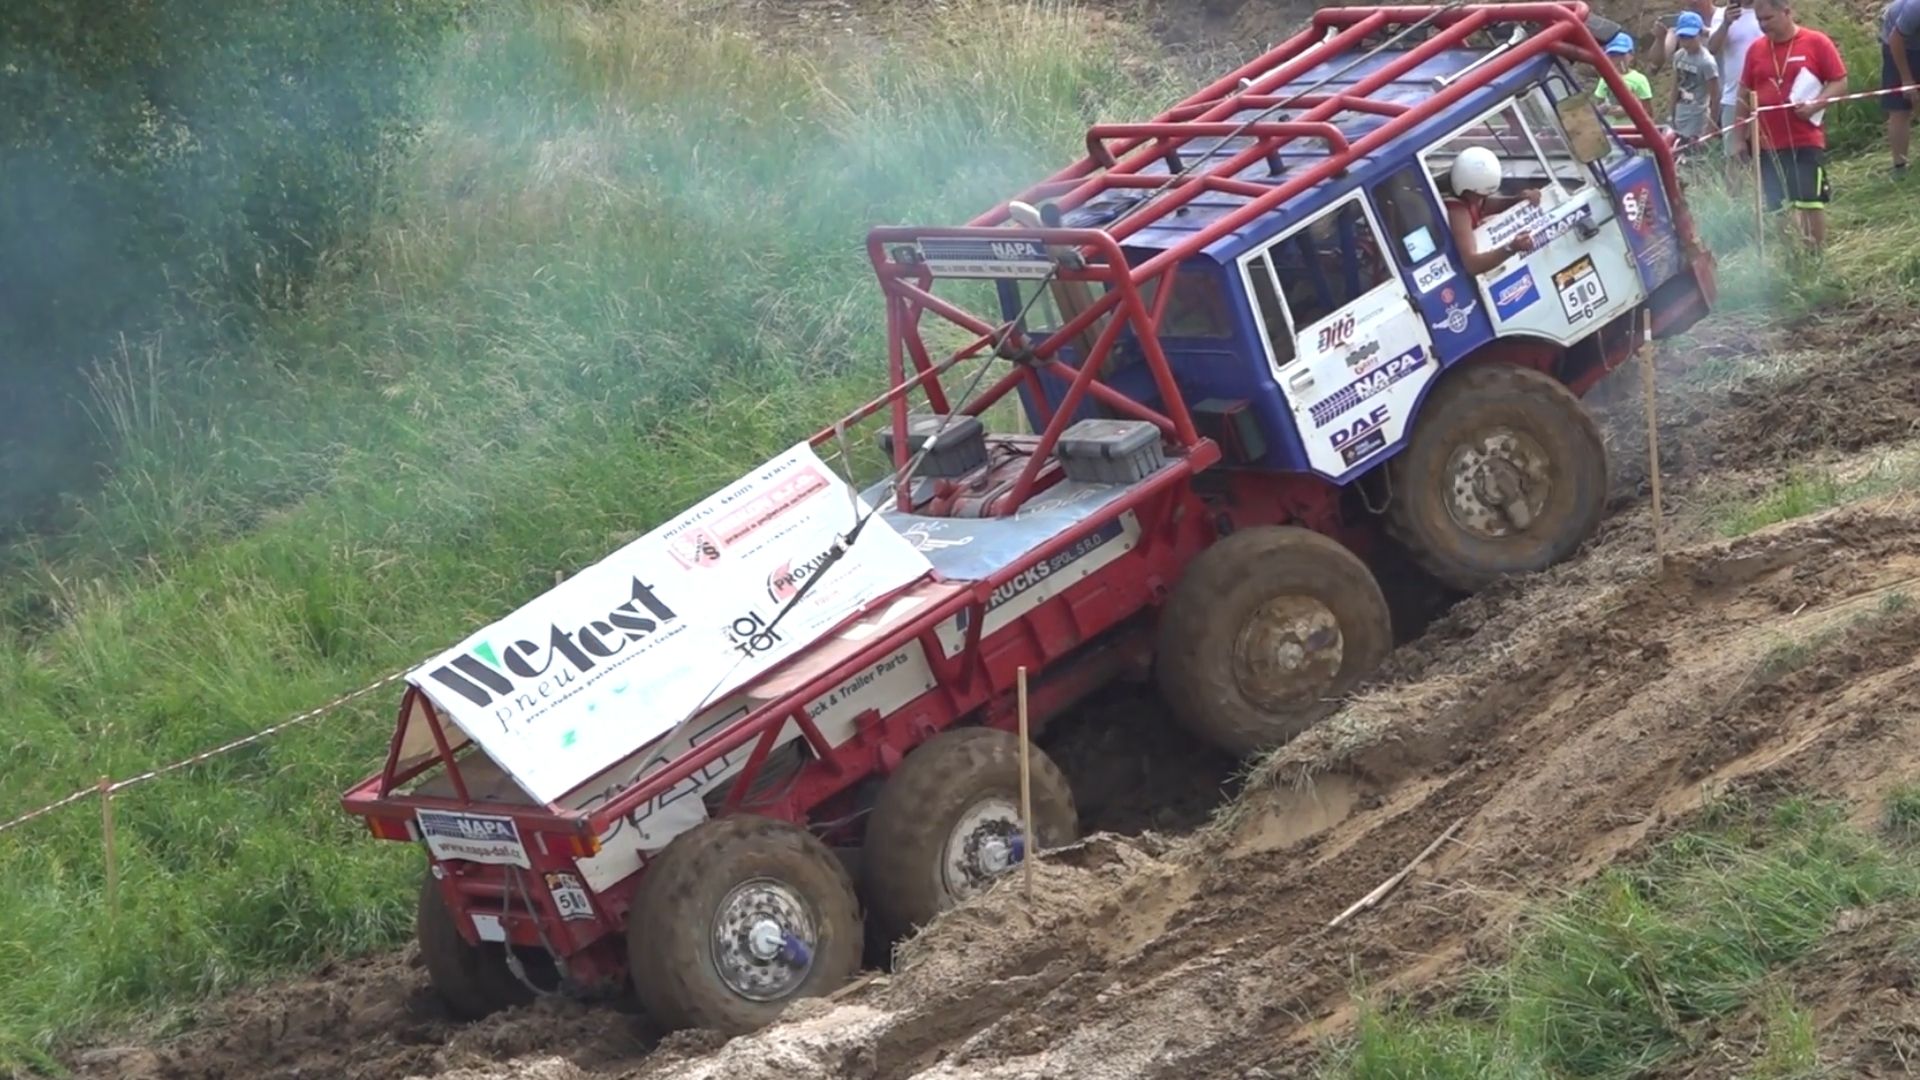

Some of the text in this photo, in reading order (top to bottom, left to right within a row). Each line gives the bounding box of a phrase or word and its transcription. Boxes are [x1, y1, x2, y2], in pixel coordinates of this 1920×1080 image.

[1545, 209, 1585, 238] NAPA
[990, 242, 1037, 257] NAPA
[1584, 304, 1594, 319] 6
[1354, 353, 1416, 397] NAPA
[1329, 403, 1389, 449] DAF
[773, 550, 838, 592] PROXIM
[985, 559, 1050, 609] RUCKS
[429, 575, 678, 708] Wetest
[495, 667, 576, 734] pneu
[808, 652, 909, 718] uck & Trailer Parts
[456, 818, 511, 836] NAPA
